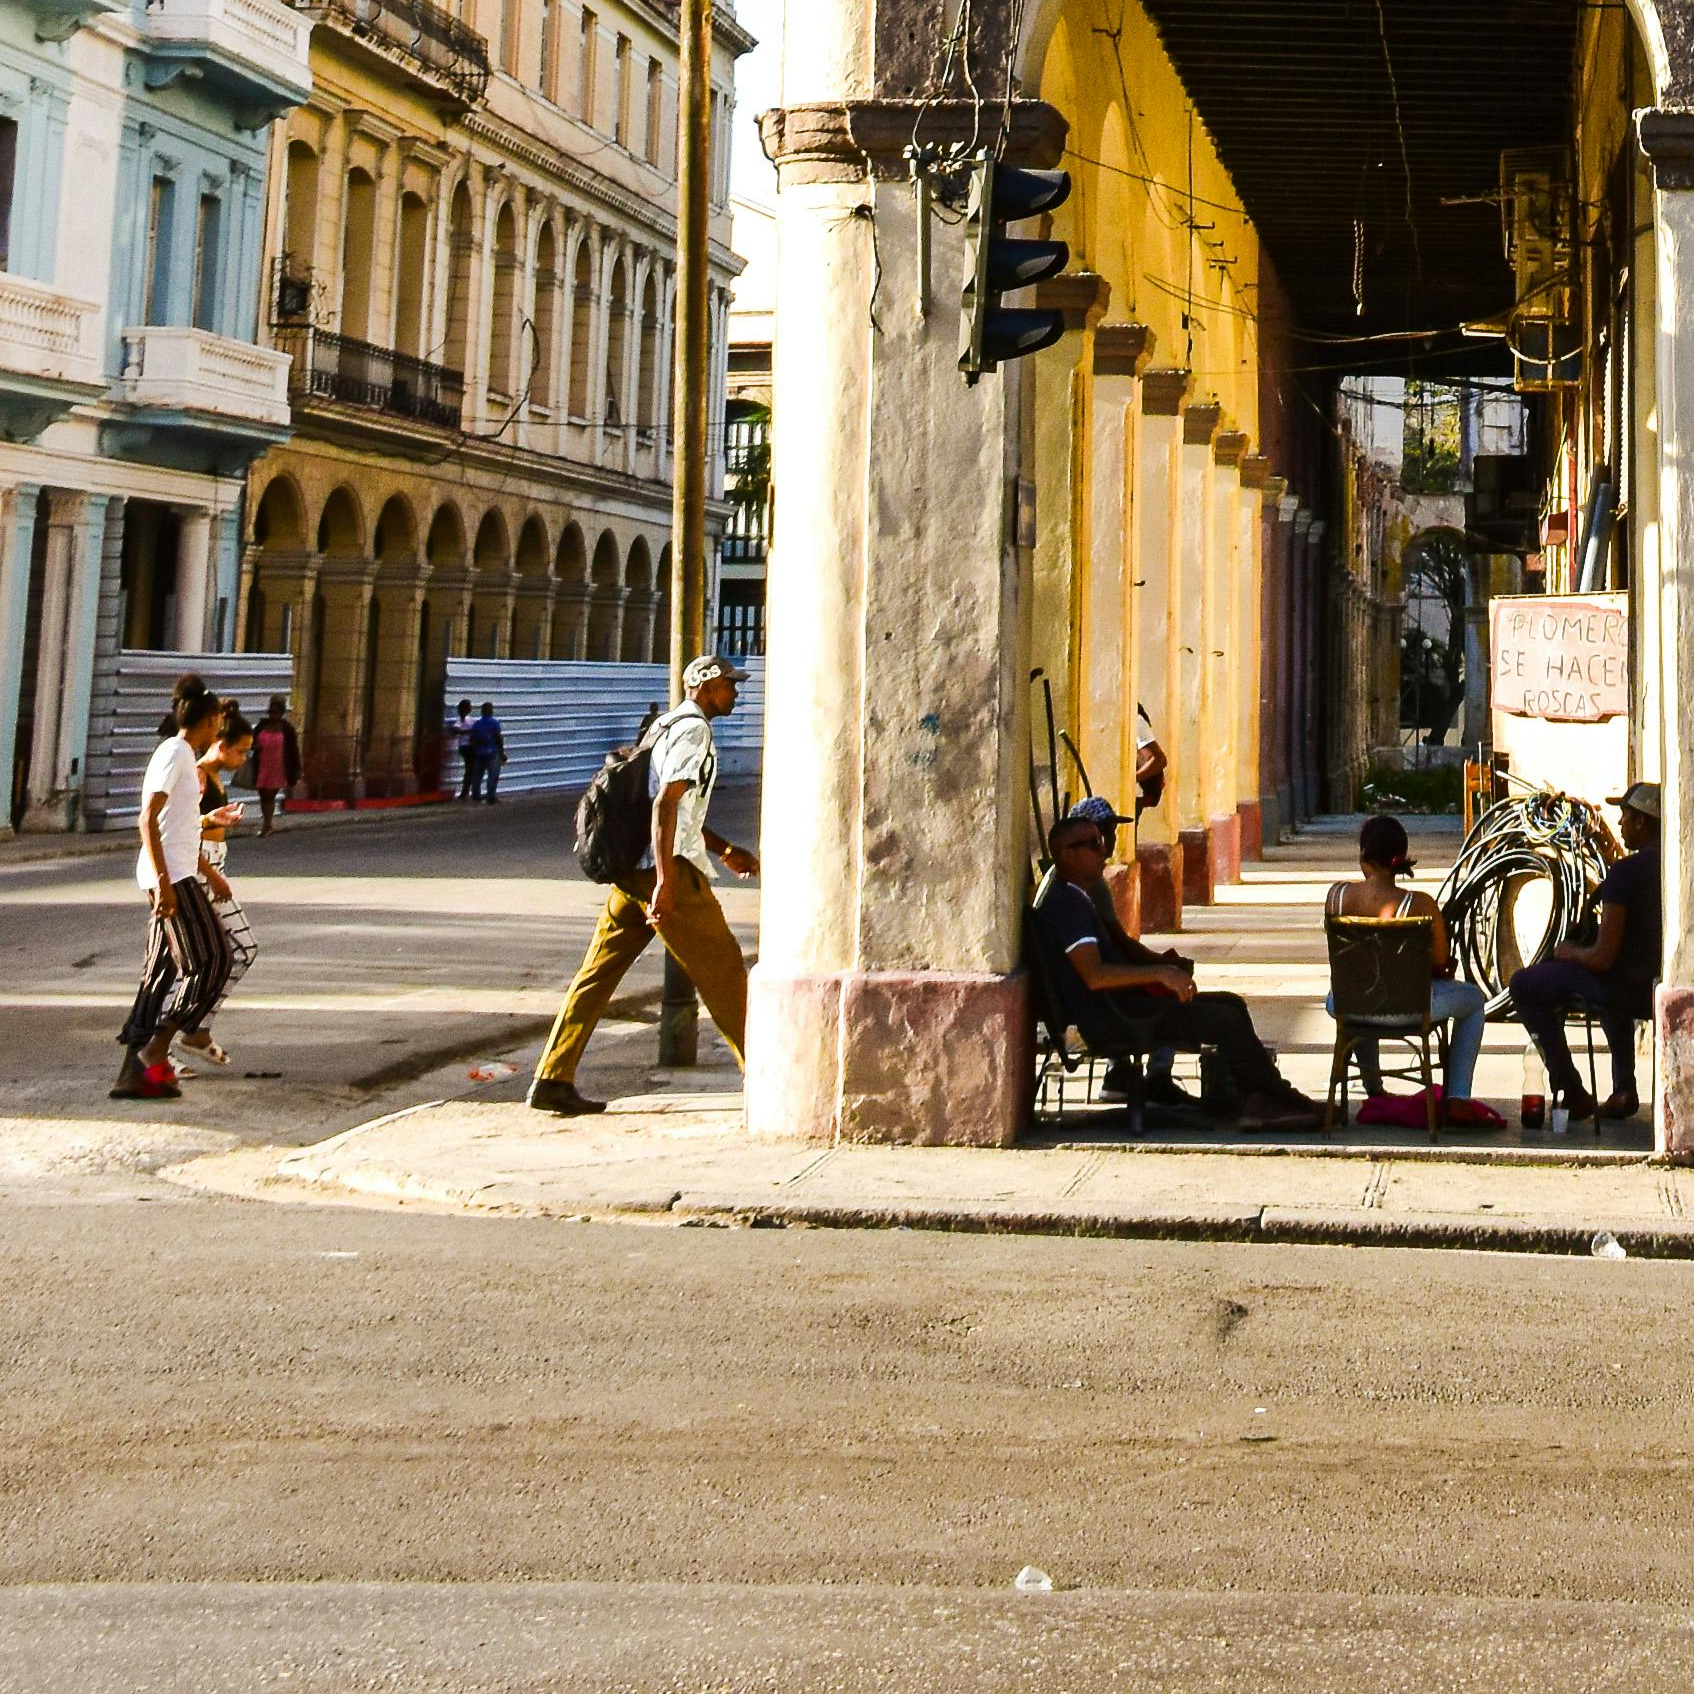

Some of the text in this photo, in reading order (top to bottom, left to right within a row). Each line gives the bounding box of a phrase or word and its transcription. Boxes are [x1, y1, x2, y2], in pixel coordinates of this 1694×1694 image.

[1500, 649, 1627, 687] SE HACE
[1523, 689, 1601, 714] ROSCAS
